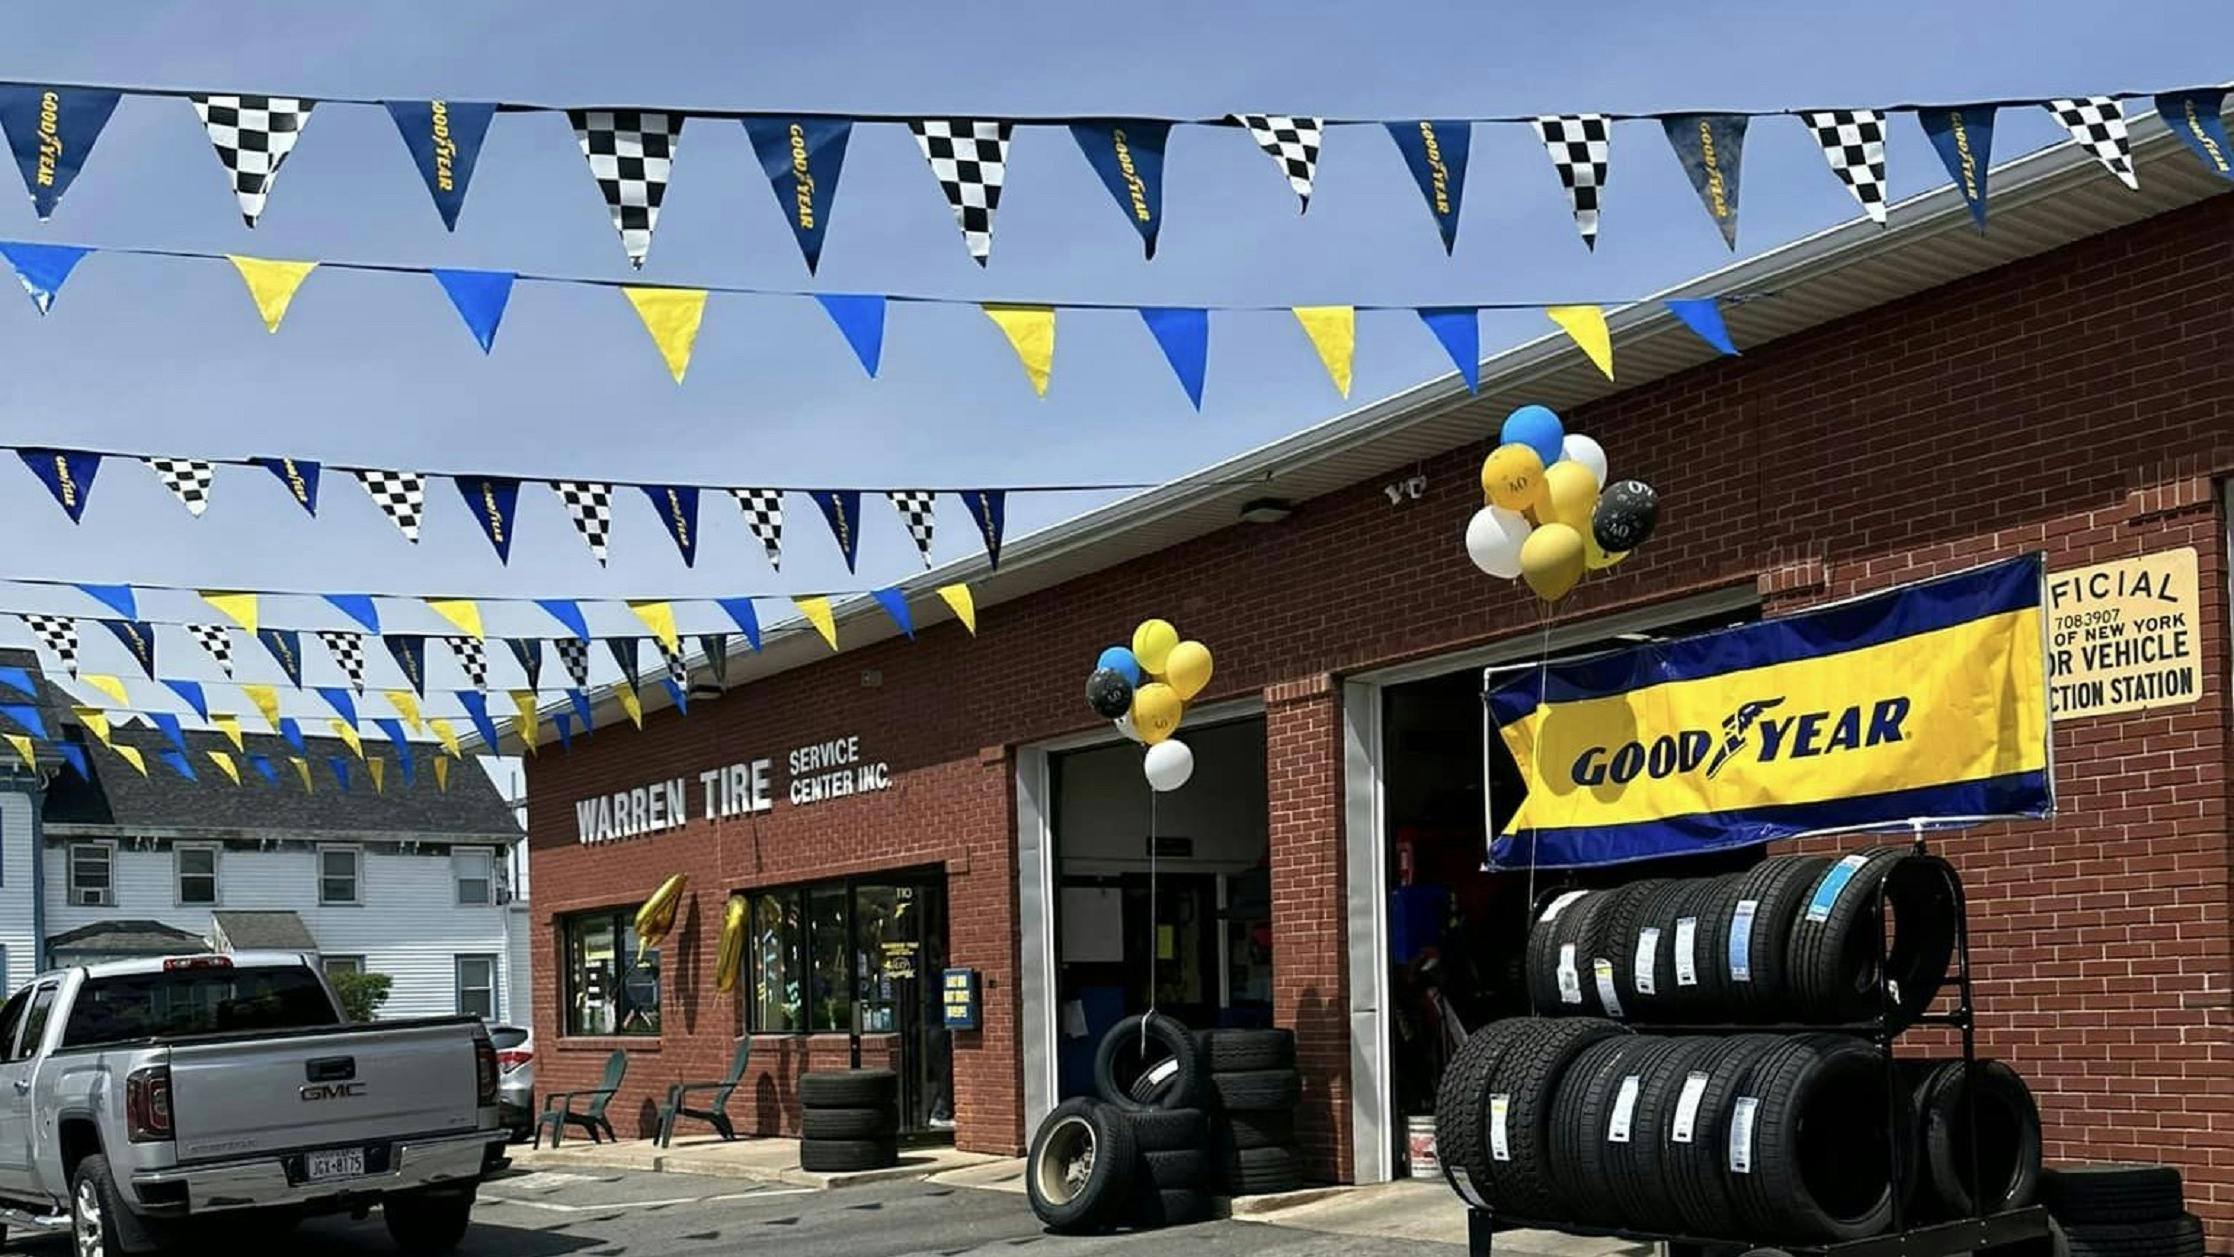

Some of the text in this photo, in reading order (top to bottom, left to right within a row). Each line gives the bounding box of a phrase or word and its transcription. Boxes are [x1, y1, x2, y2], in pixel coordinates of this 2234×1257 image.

[37, 90, 62, 187] GOODYEAR
[789, 123, 815, 229] GOODYEAR
[2051, 570, 2179, 609] FICIAL
[2054, 612, 2186, 647] OF NEW YORK
[2081, 630, 2190, 671] VEHICLE
[2111, 666, 2193, 703] STATION
[789, 736, 859, 776] SERVICE
[576, 757, 773, 845] WARREN TIRE
[790, 762, 893, 806] CENTER INC.
[301, 1082, 367, 1101] GMC
